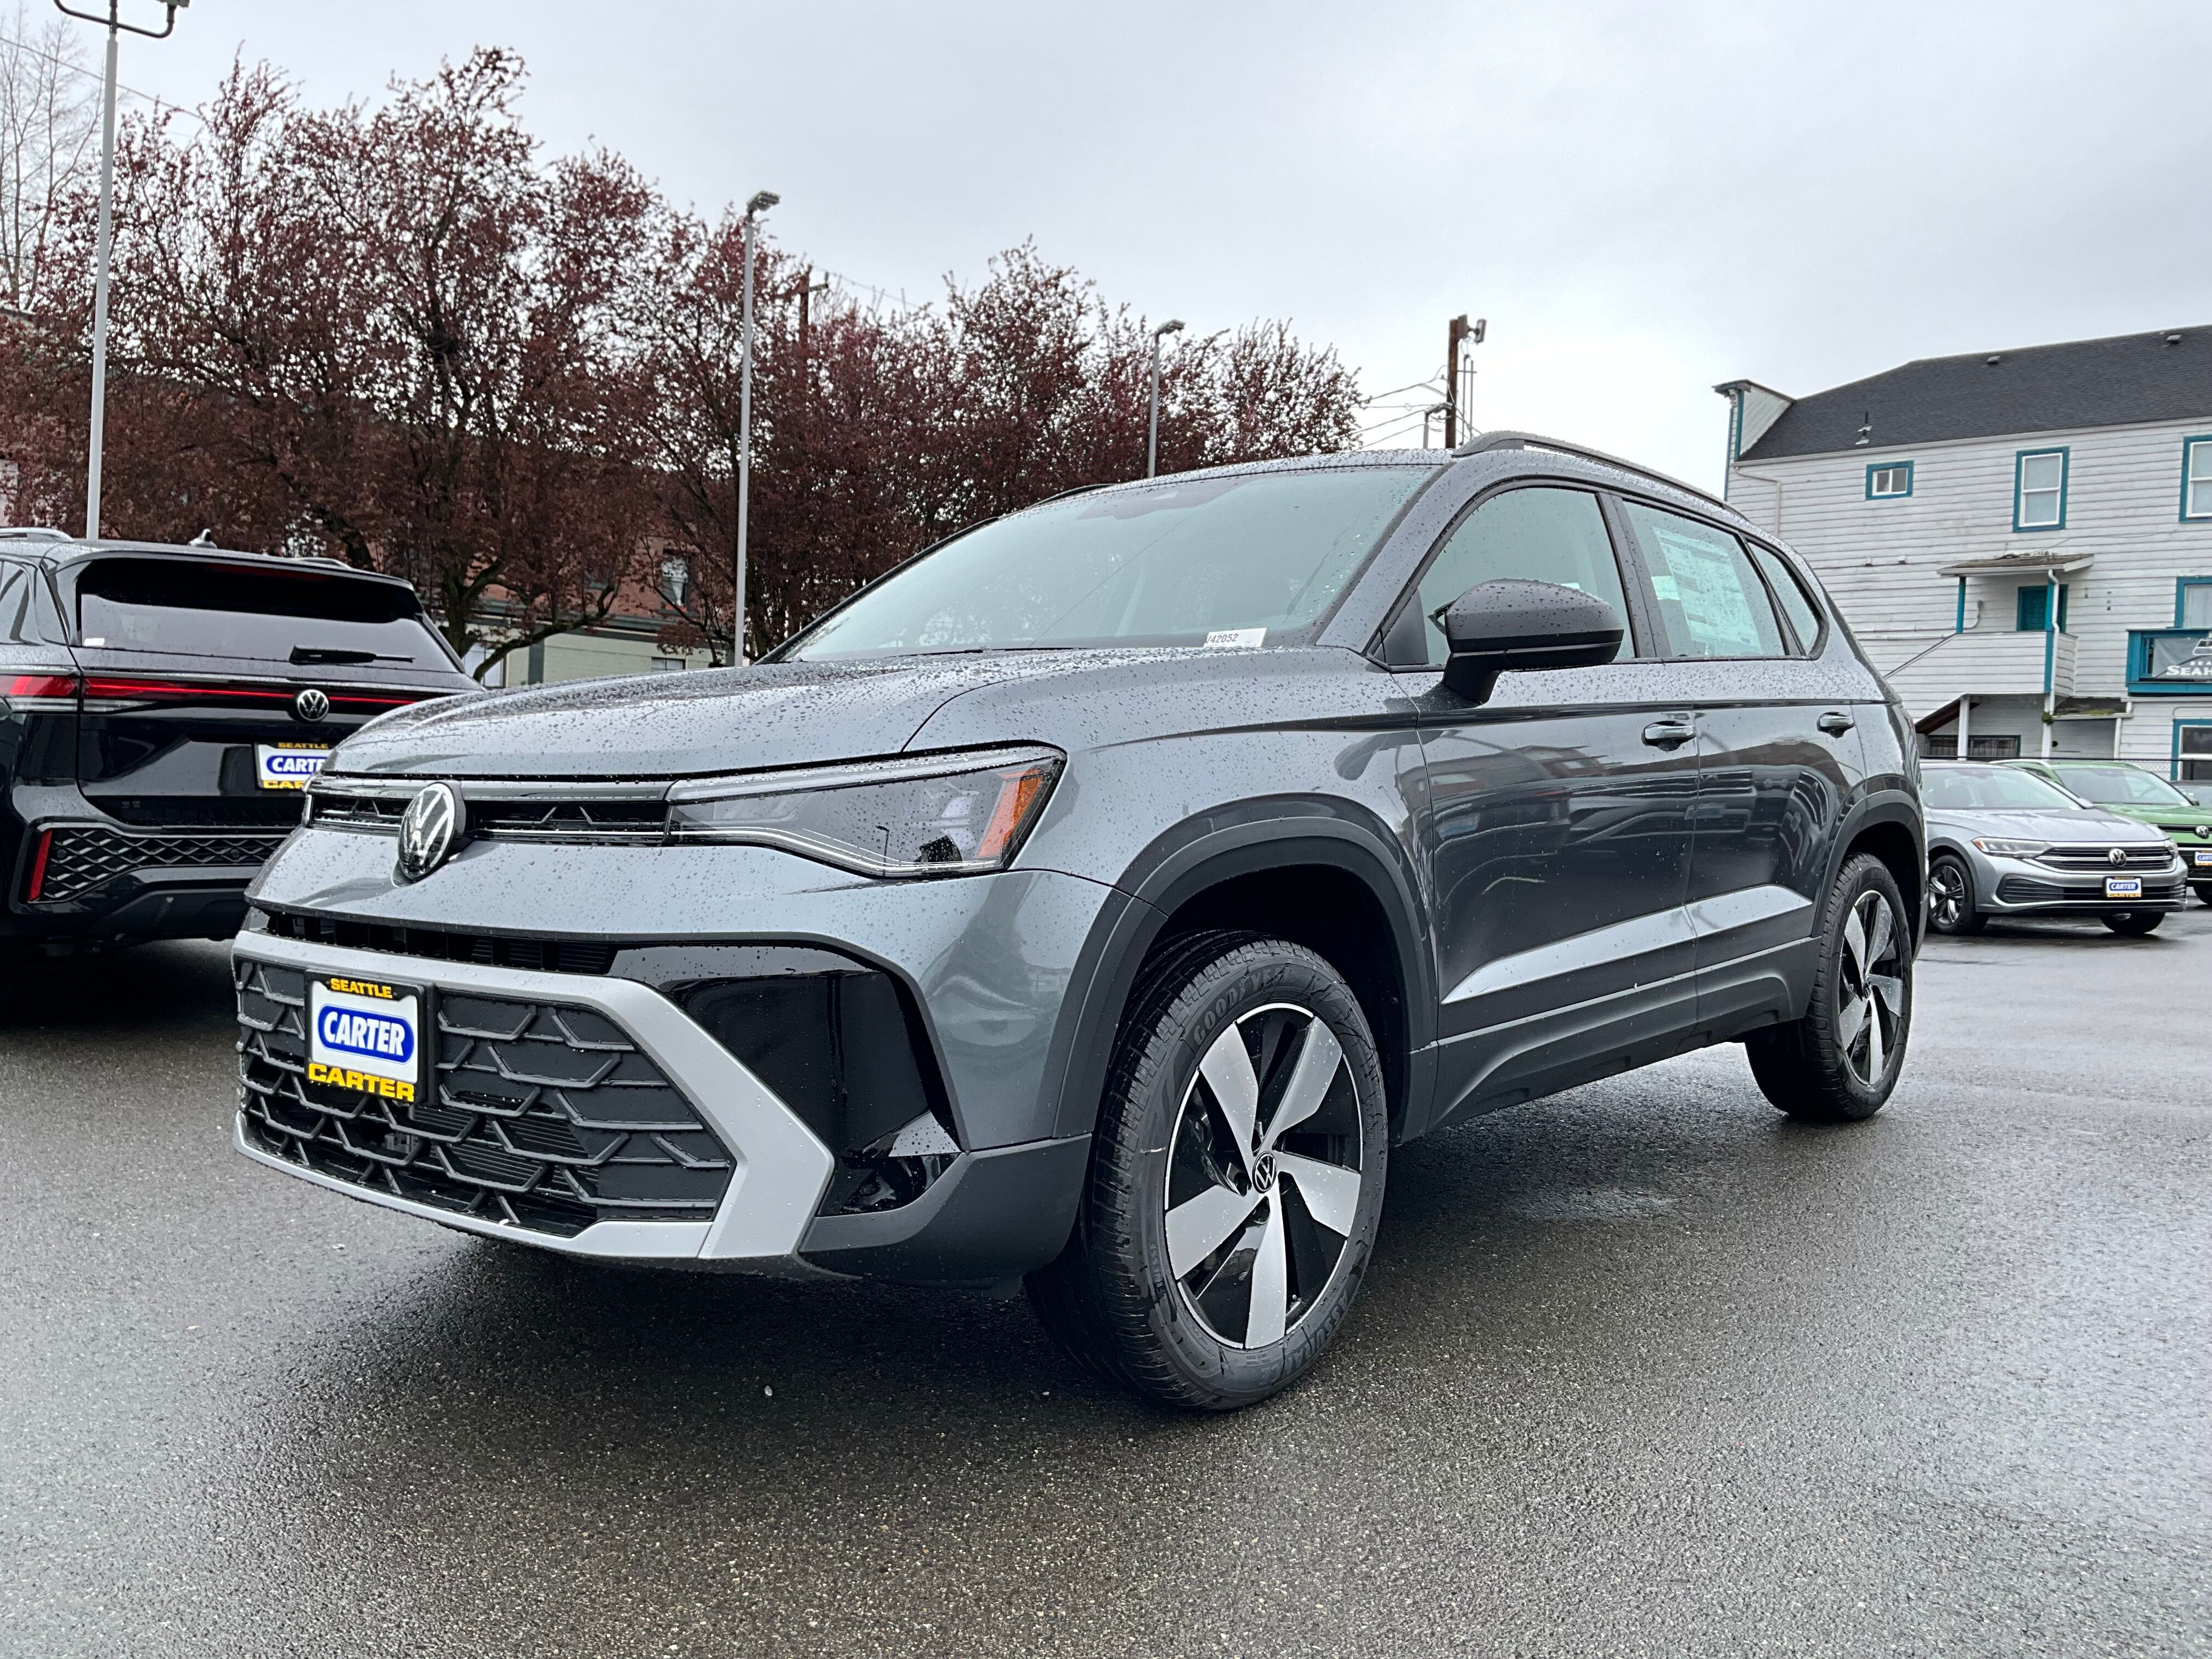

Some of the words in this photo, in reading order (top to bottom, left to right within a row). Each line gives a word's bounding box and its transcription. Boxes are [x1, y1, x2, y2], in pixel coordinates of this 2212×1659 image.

[272, 758, 325, 772] CARTE
[330, 978, 393, 998] SEATTLE
[324, 1011, 405, 1057] CARTER
[308, 1063, 415, 1102] CARTER
